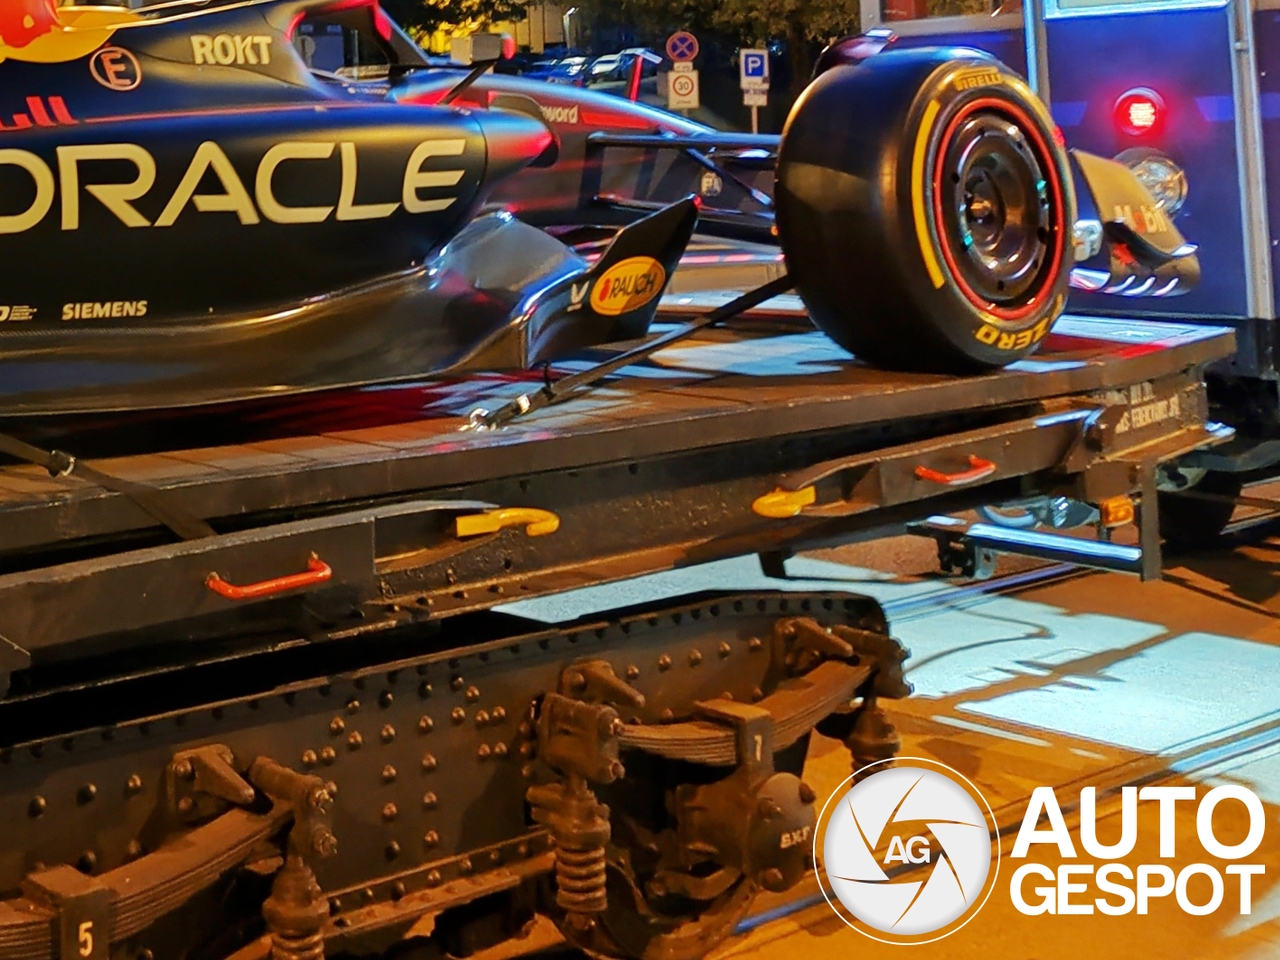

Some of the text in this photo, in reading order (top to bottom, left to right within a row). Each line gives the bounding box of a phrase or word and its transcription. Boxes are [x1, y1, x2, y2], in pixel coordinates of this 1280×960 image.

[190, 34, 272, 65] ROKT
[747, 56, 761, 74] P
[677, 81, 690, 91] 30
[953, 66, 1004, 91] PIRELLI
[609, 273, 658, 299] RAUCH
[62, 300, 148, 320] SIEMENS
[975, 317, 1050, 350] ZERO
[79, 921, 93, 957] 5
